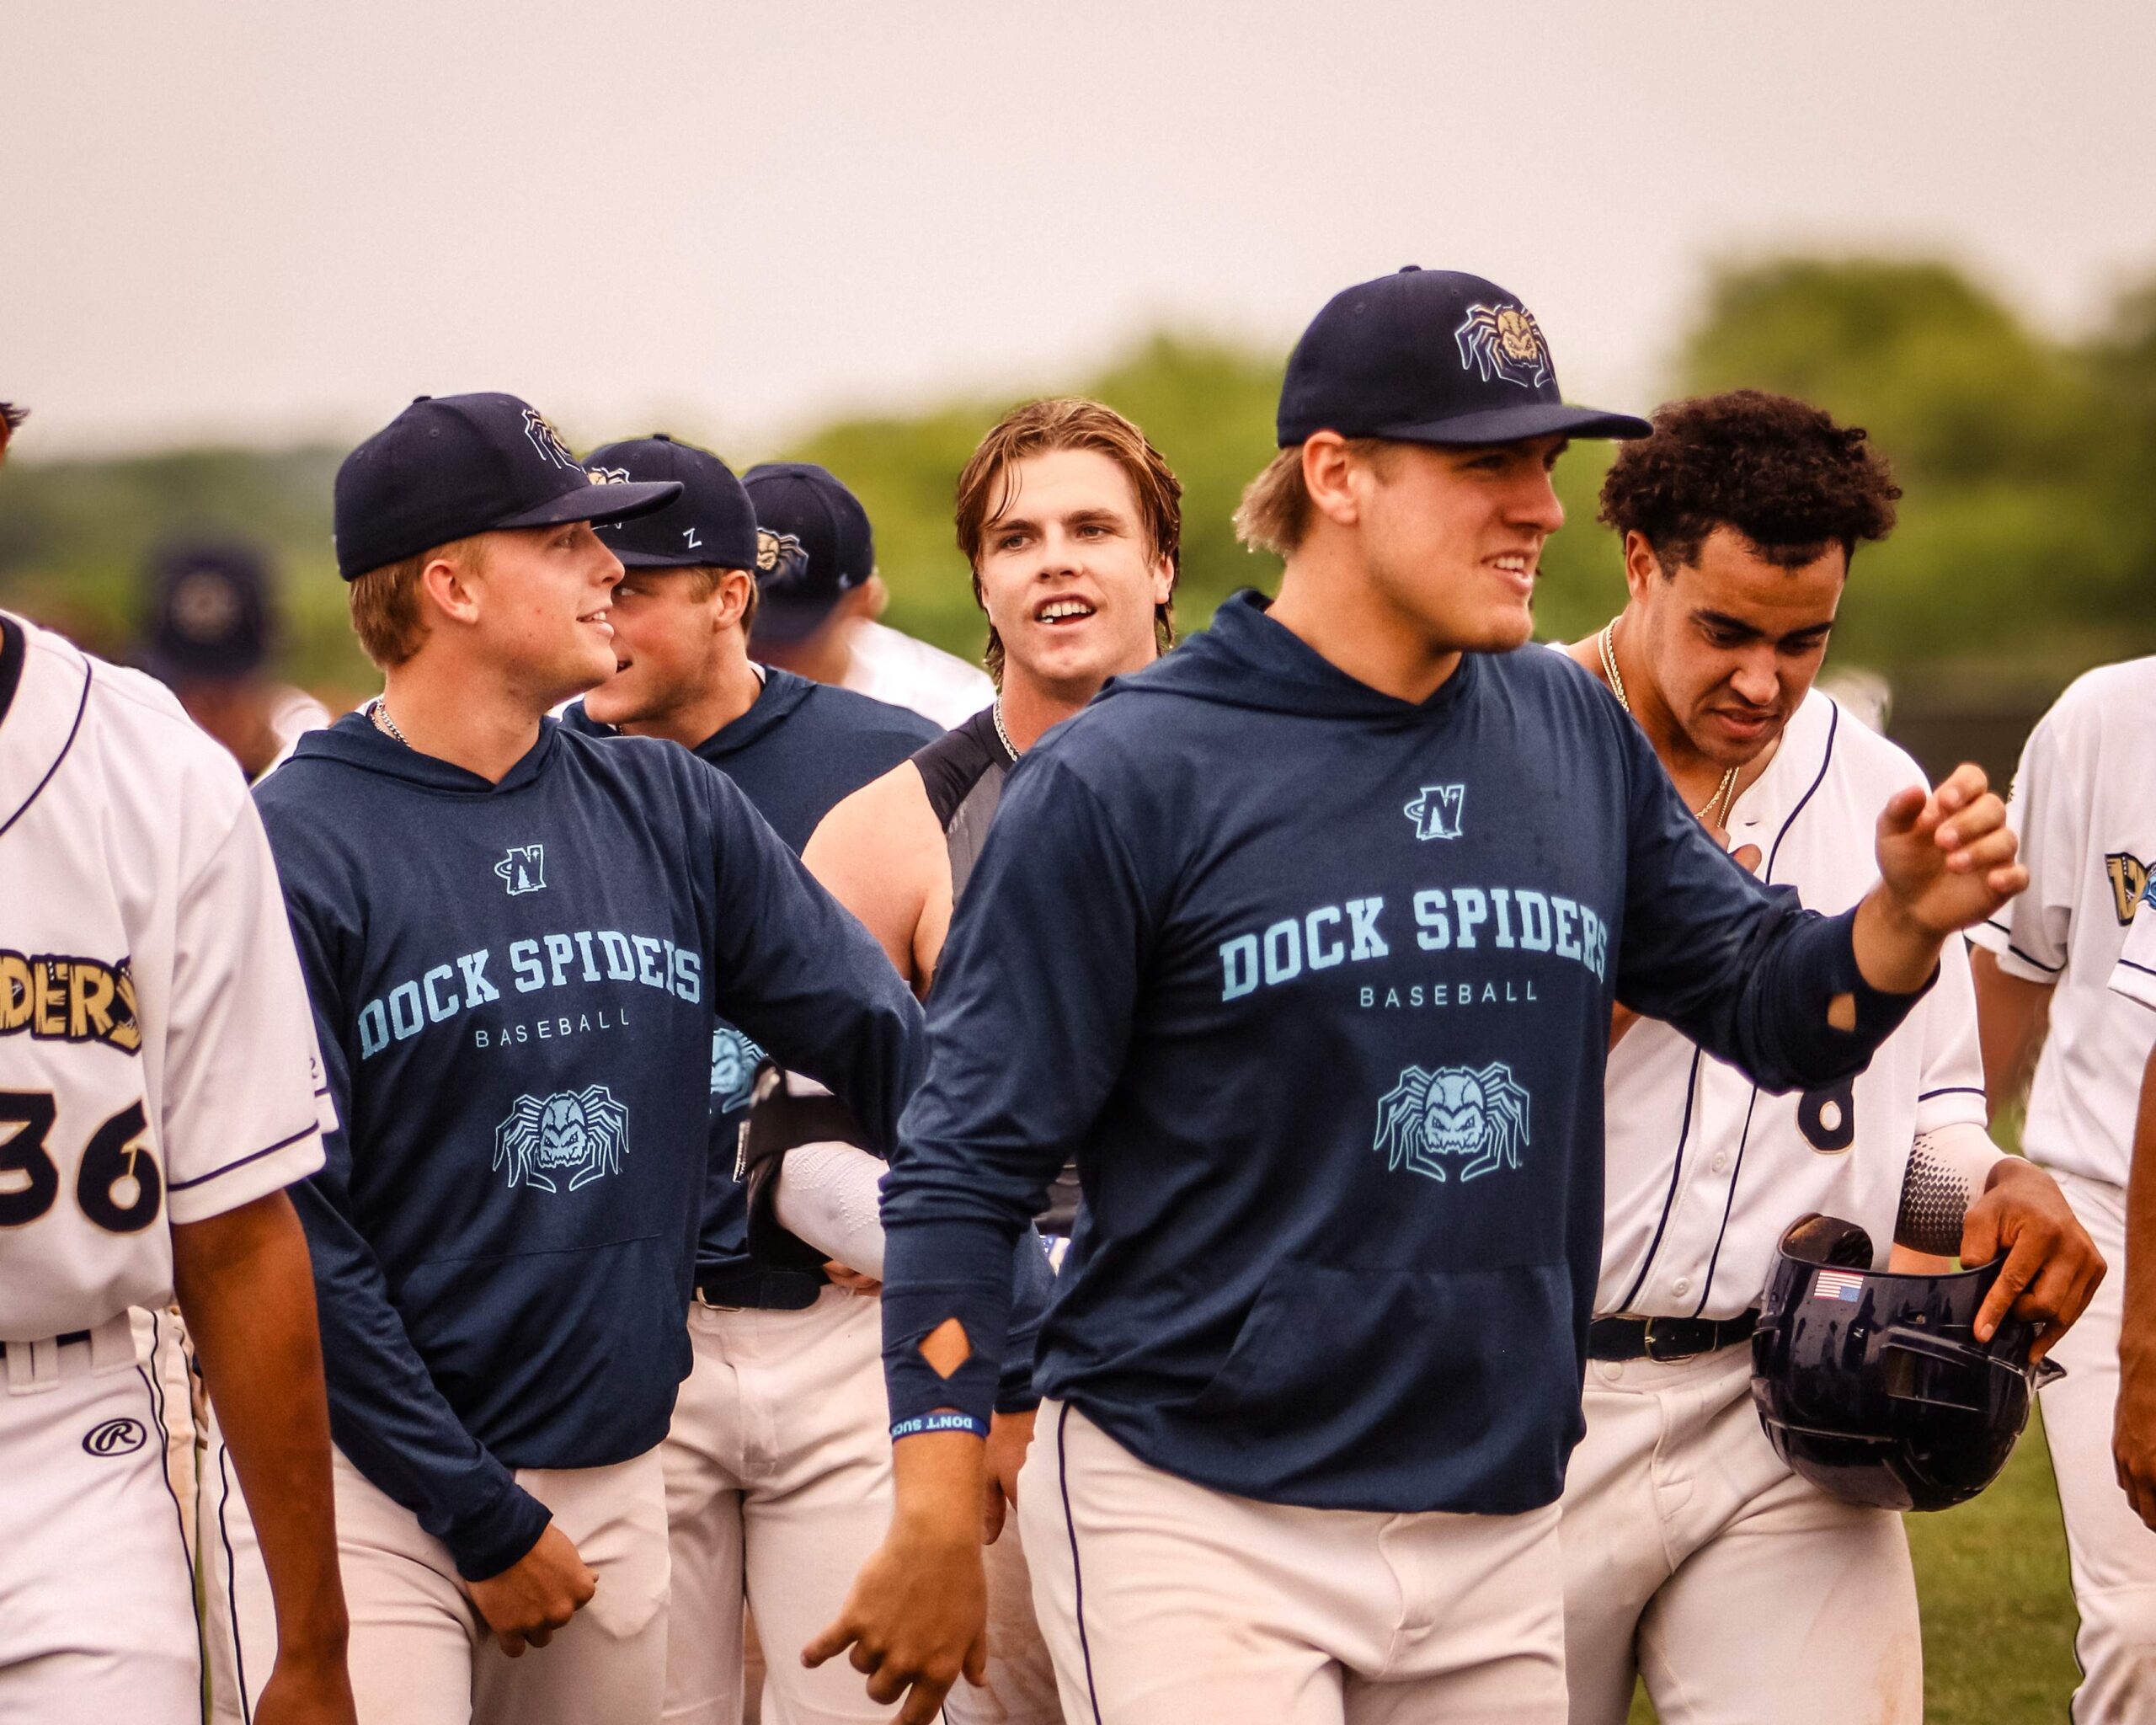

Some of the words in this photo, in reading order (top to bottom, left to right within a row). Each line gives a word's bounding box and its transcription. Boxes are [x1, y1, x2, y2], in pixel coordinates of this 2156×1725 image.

[682, 527, 702, 549] Z
[1404, 784, 1465, 841] N
[494, 844, 547, 896] N
[1219, 896, 1390, 1001] DOCK
[1413, 888, 1608, 984] SPIDERS
[357, 948, 500, 1060] DOCK
[1361, 980, 1537, 1007] BASEBALL
[476, 1008, 630, 1048] BASEBALL
[0, 1091, 164, 1236] 36
[93, 1420, 139, 1453] R
[926, 1415, 973, 1429] DON'T
